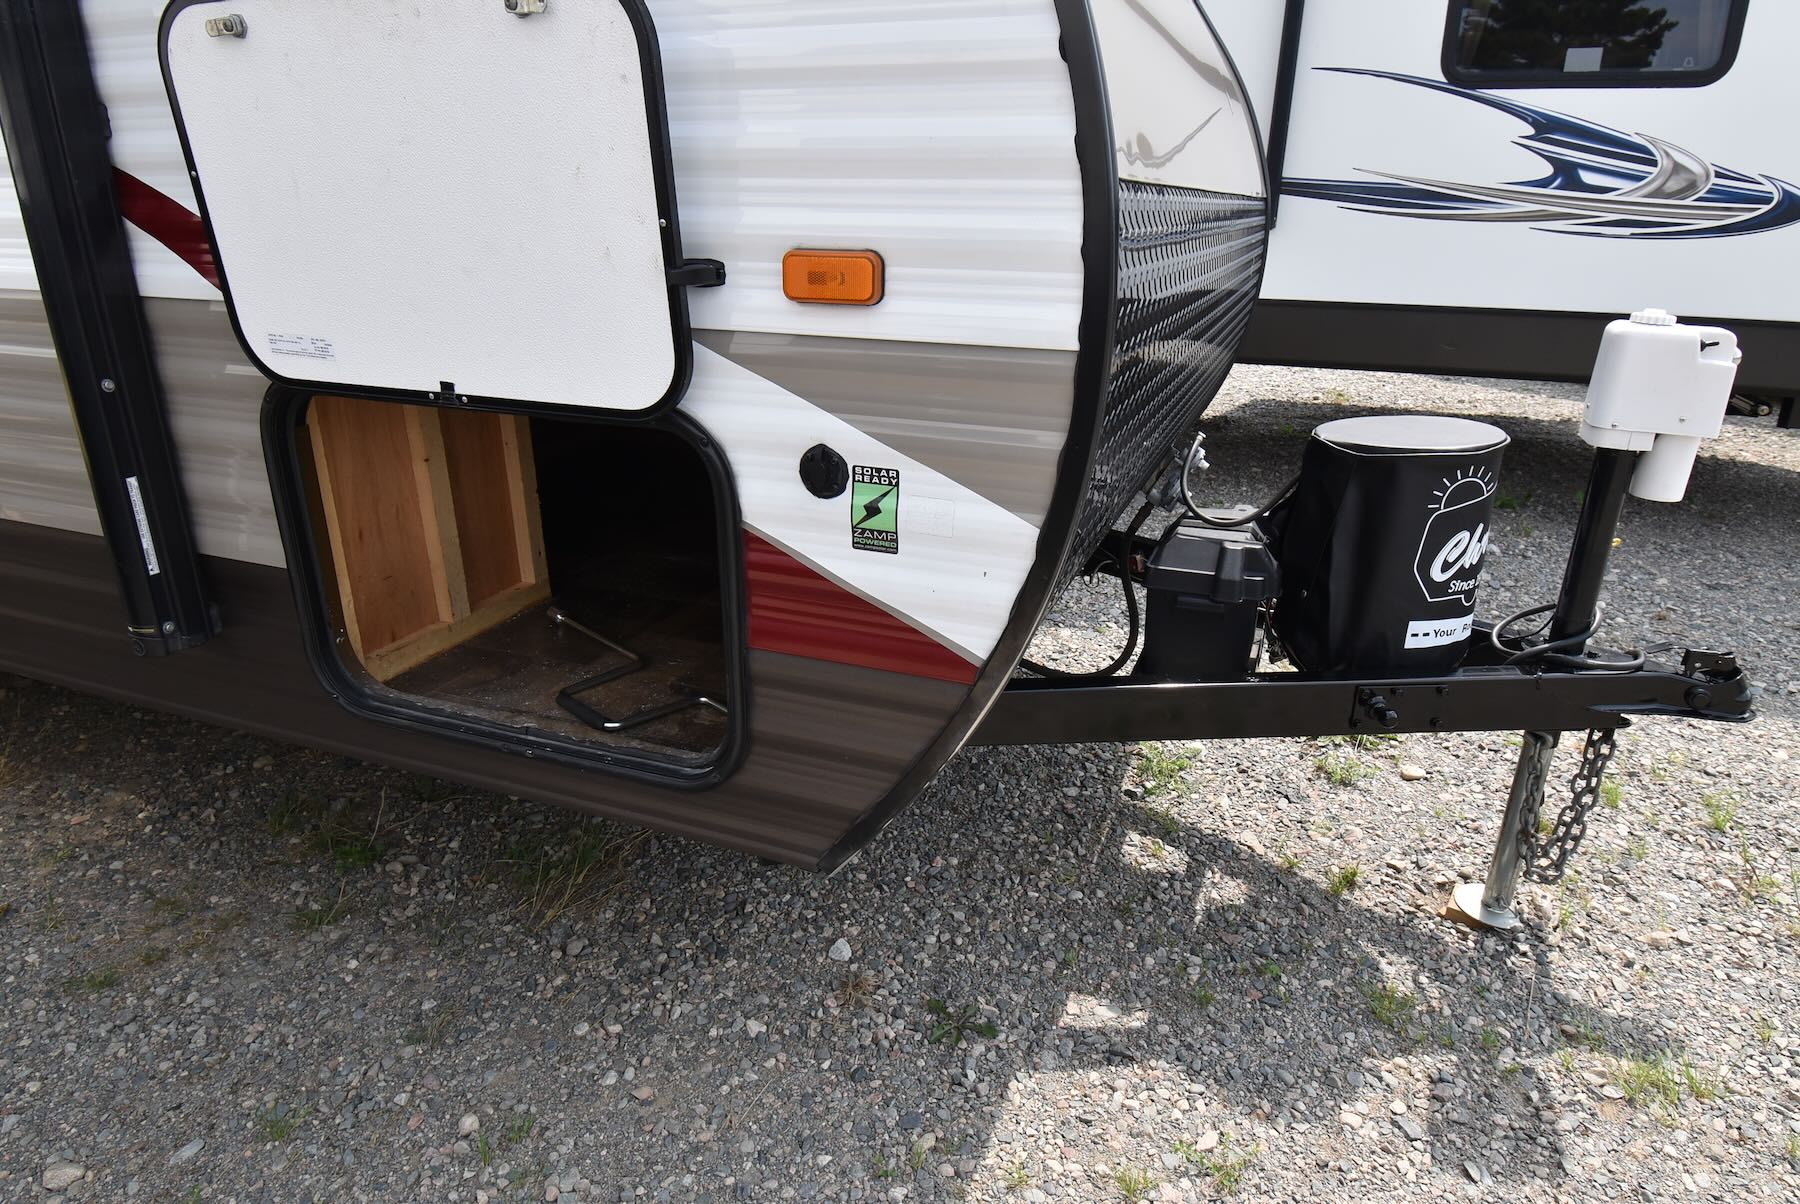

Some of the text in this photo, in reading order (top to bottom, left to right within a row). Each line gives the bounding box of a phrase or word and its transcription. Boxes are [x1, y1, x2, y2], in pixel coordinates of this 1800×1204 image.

[855, 467, 897, 478] SOLAR
[855, 474, 898, 486] READY
[854, 528, 897, 541] ZAMP
[854, 538, 897, 548] POWERED
[1448, 579, 1475, 593] Since
[1433, 628, 1457, 640] Your
